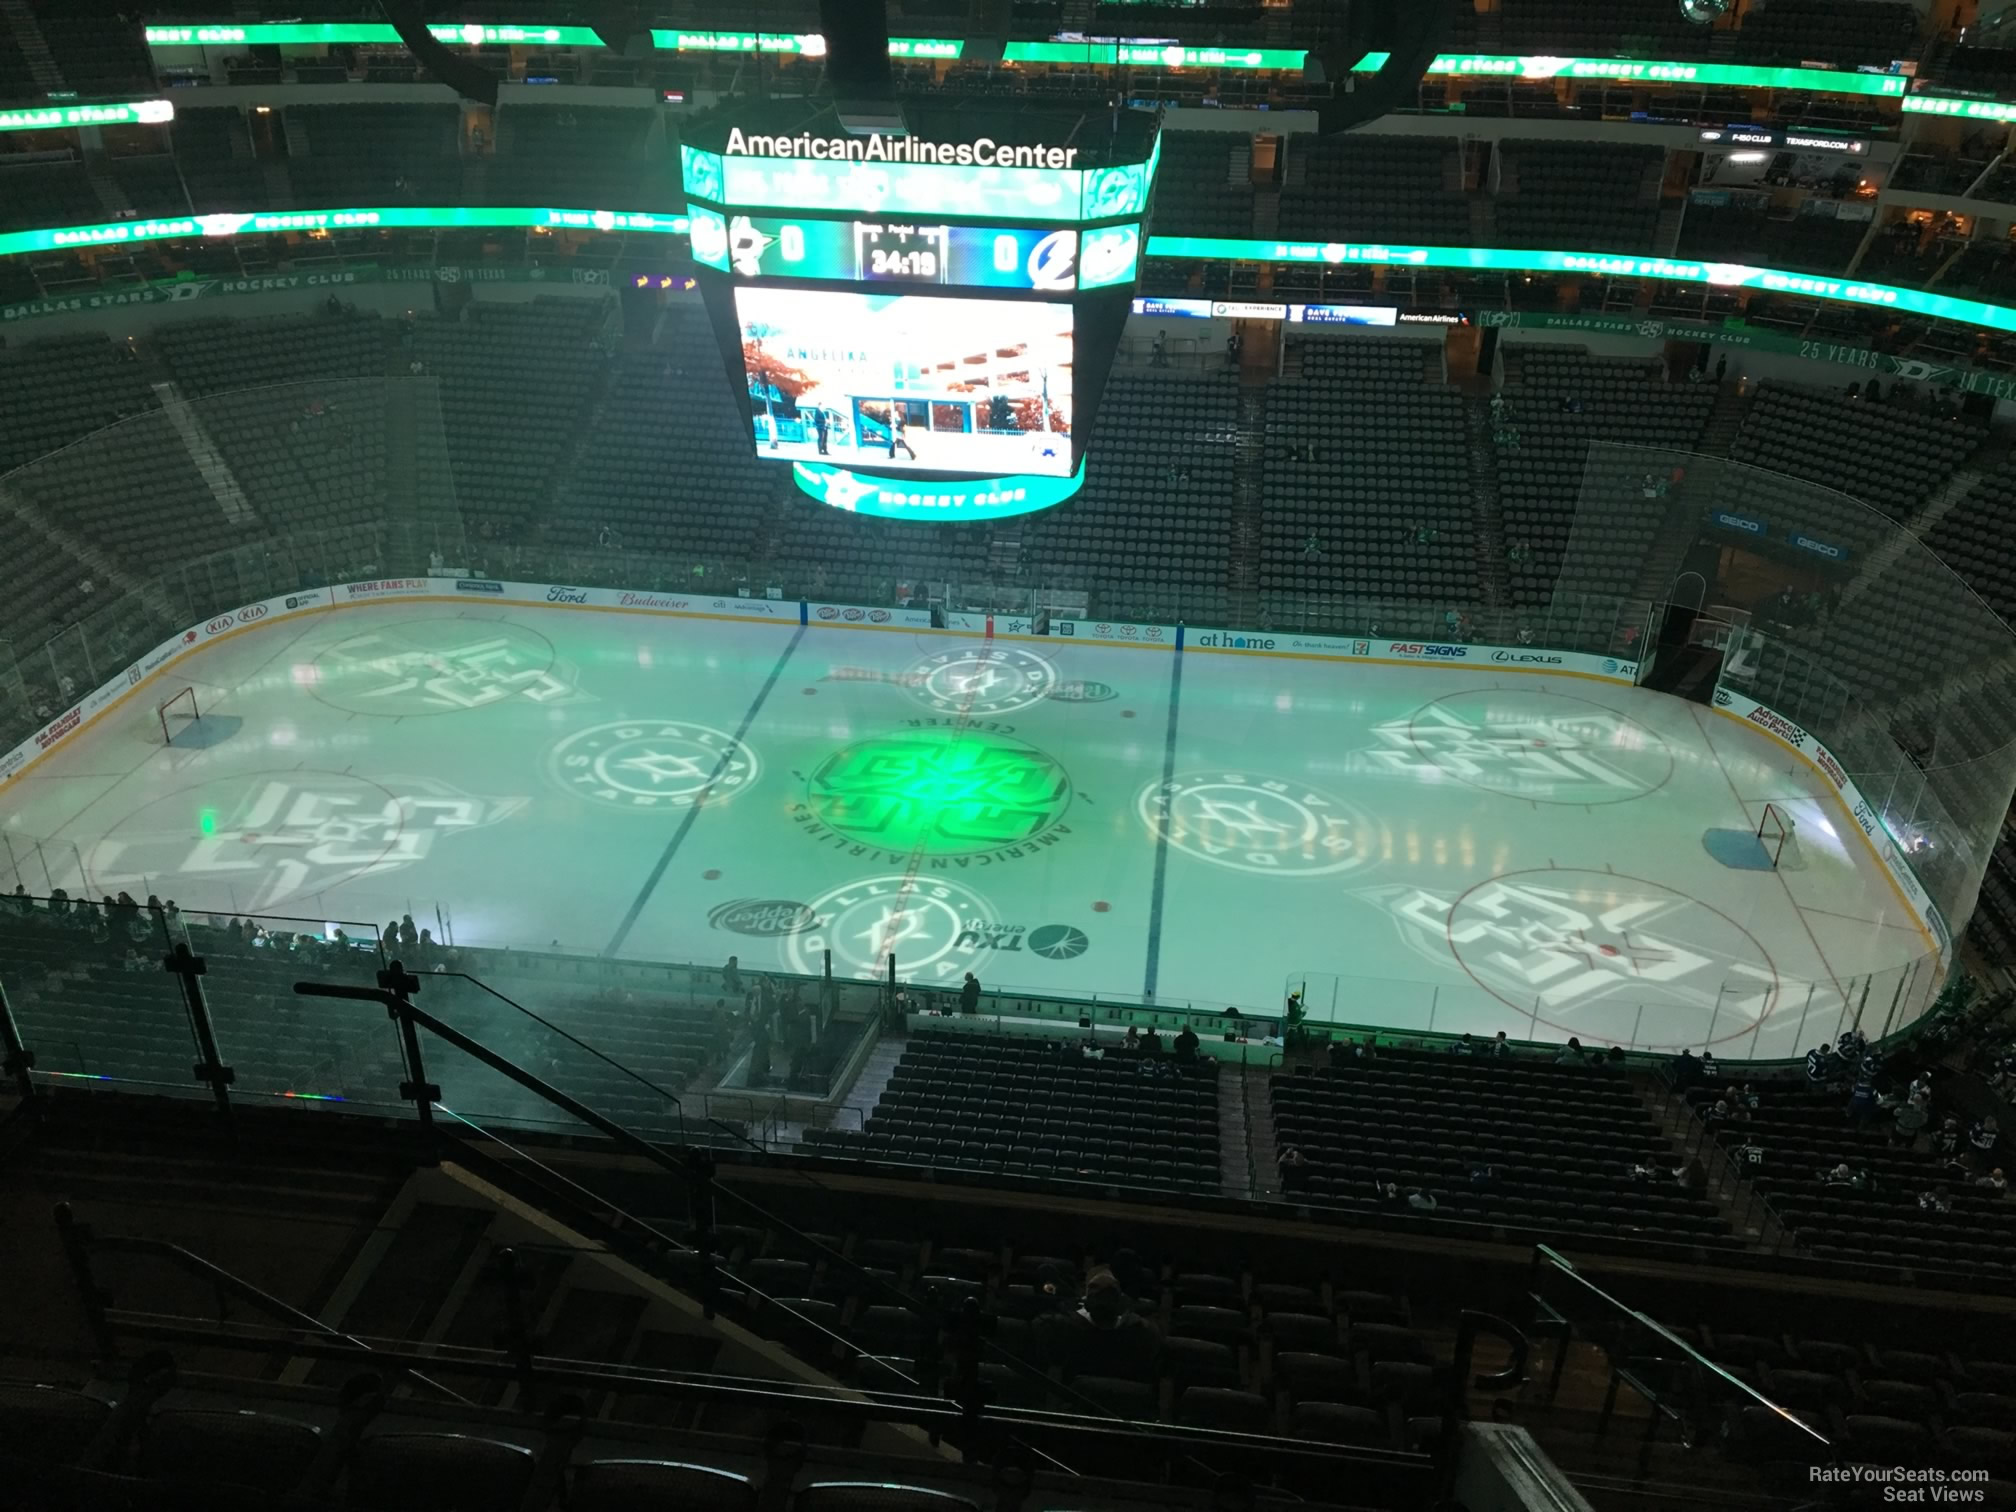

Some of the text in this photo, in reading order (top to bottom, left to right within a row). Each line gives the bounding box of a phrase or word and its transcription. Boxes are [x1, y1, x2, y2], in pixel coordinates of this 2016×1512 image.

[1786, 137, 1848, 149] TEXASFORD.COM
[54, 212, 380, 244] DALLAS STARS HOCKEY CLUB
[780, 225, 804, 261] 0
[872, 249, 936, 276] 34:19
[993, 235, 1018, 272] 0
[223, 272, 355, 292] HOCKEY CLUB
[402, 269, 431, 280] YEARS
[477, 269, 505, 280] TEXAS
[1563, 256, 1897, 302] DALLAS STARS HOCKEY CLUB
[4, 290, 154, 319] DALLAS STARS
[1546, 317, 1591, 328] DALLAS
[1594, 321, 1632, 331] STARS
[1667, 328, 1716, 340] HOCKEY
[1720, 334, 1750, 344] CLUB
[787, 348, 867, 361] ANGELIKA
[1800, 340, 1820, 359] 25
[1829, 344, 1878, 369] YEARS
[1960, 371, 1978, 391] IN
[1985, 376, 2016, 400] TEX
[879, 488, 1026, 507] HOCKEY CLUB
[1719, 514, 1759, 531] GEICO
[1796, 537, 1838, 557] GEICO
[347, 578, 428, 594] WHERE FANS PLAY
[546, 586, 587, 604] Ford
[617, 592, 688, 609] Budweiser
[241, 606, 264, 620] KIA
[905, 616, 931, 624] America
[209, 617, 231, 633] KIA
[1200, 632, 1275, 649] at home
[1389, 642, 1467, 657] FASTSIGNS
[1510, 654, 1562, 664] LEXUS
[908, 717, 1016, 734] CENTER
[1747, 712, 1790, 740] Auto Parts
[1754, 706, 1793, 733] Advance
[1854, 800, 1875, 836] Ford
[790, 802, 902, 866] AIRLINES
[931, 823, 1073, 869] AMERICAN
[746, 916, 777, 931] Dr
[952, 931, 1023, 952] TXU
